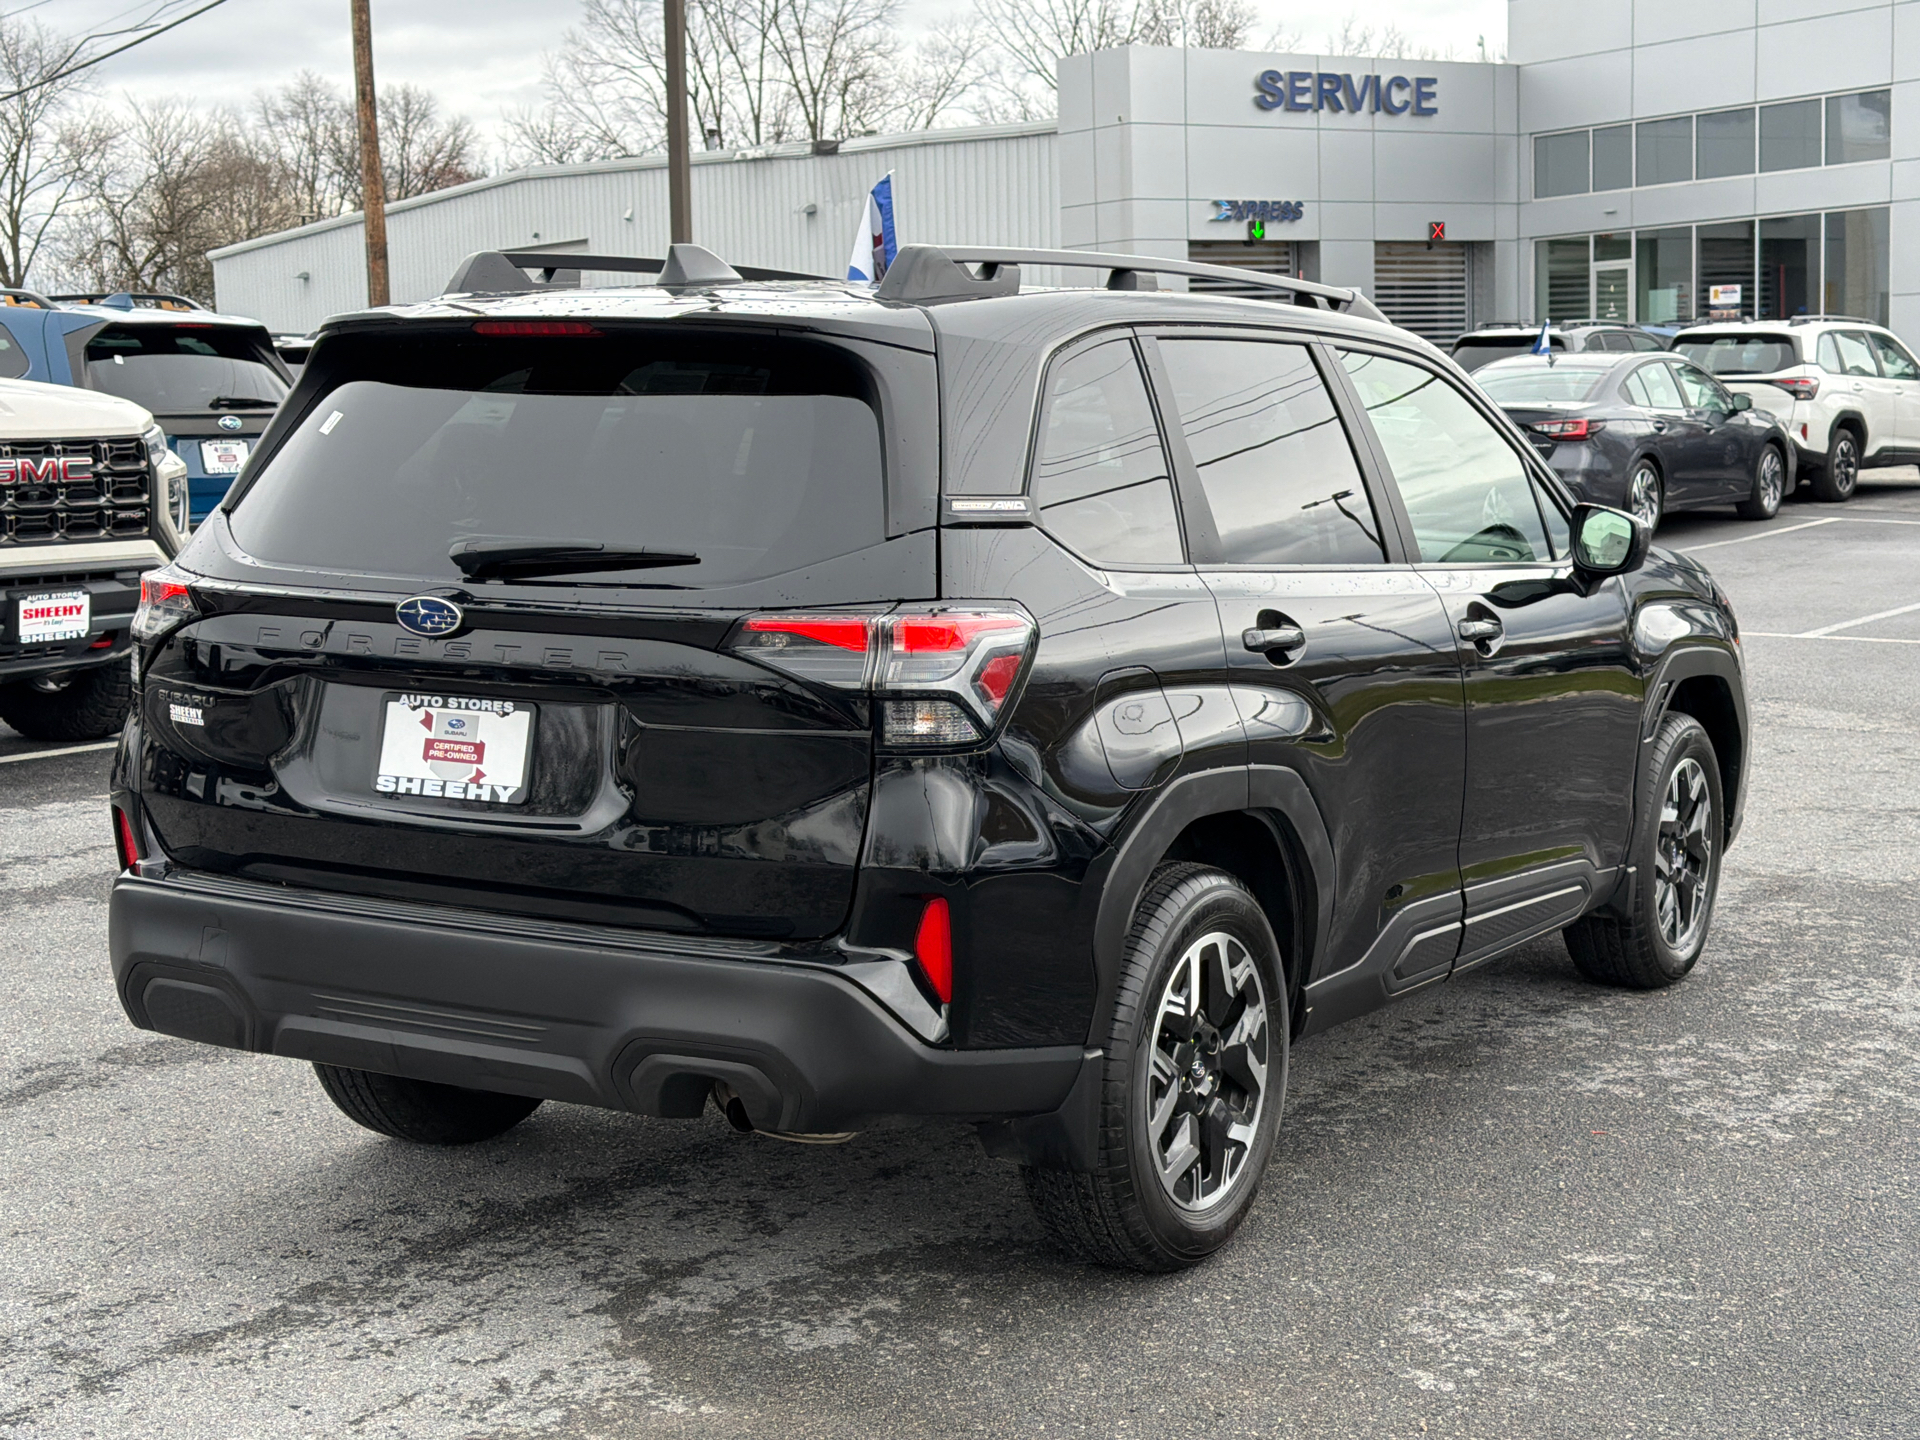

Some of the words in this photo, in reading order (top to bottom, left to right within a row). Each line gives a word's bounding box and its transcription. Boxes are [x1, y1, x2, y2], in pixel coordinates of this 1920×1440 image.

[1253, 69, 1438, 116] SERVICE
[1211, 200, 1304, 221] EXPRESS
[992, 501, 1026, 510] AWD
[51, 591, 83, 599] STORES
[23, 604, 84, 619] SHEEHY
[20, 629, 88, 644] SHEEHY
[256, 626, 630, 671] FORESTER
[158, 689, 216, 708] SUBARU
[399, 694, 443, 708] AUTO
[447, 699, 515, 713] STORES
[170, 704, 202, 719] SHEEHY
[433, 742, 475, 753] CERTIFIED
[428, 750, 478, 761] PRE-OWNED
[375, 775, 518, 803] SHEEHY
